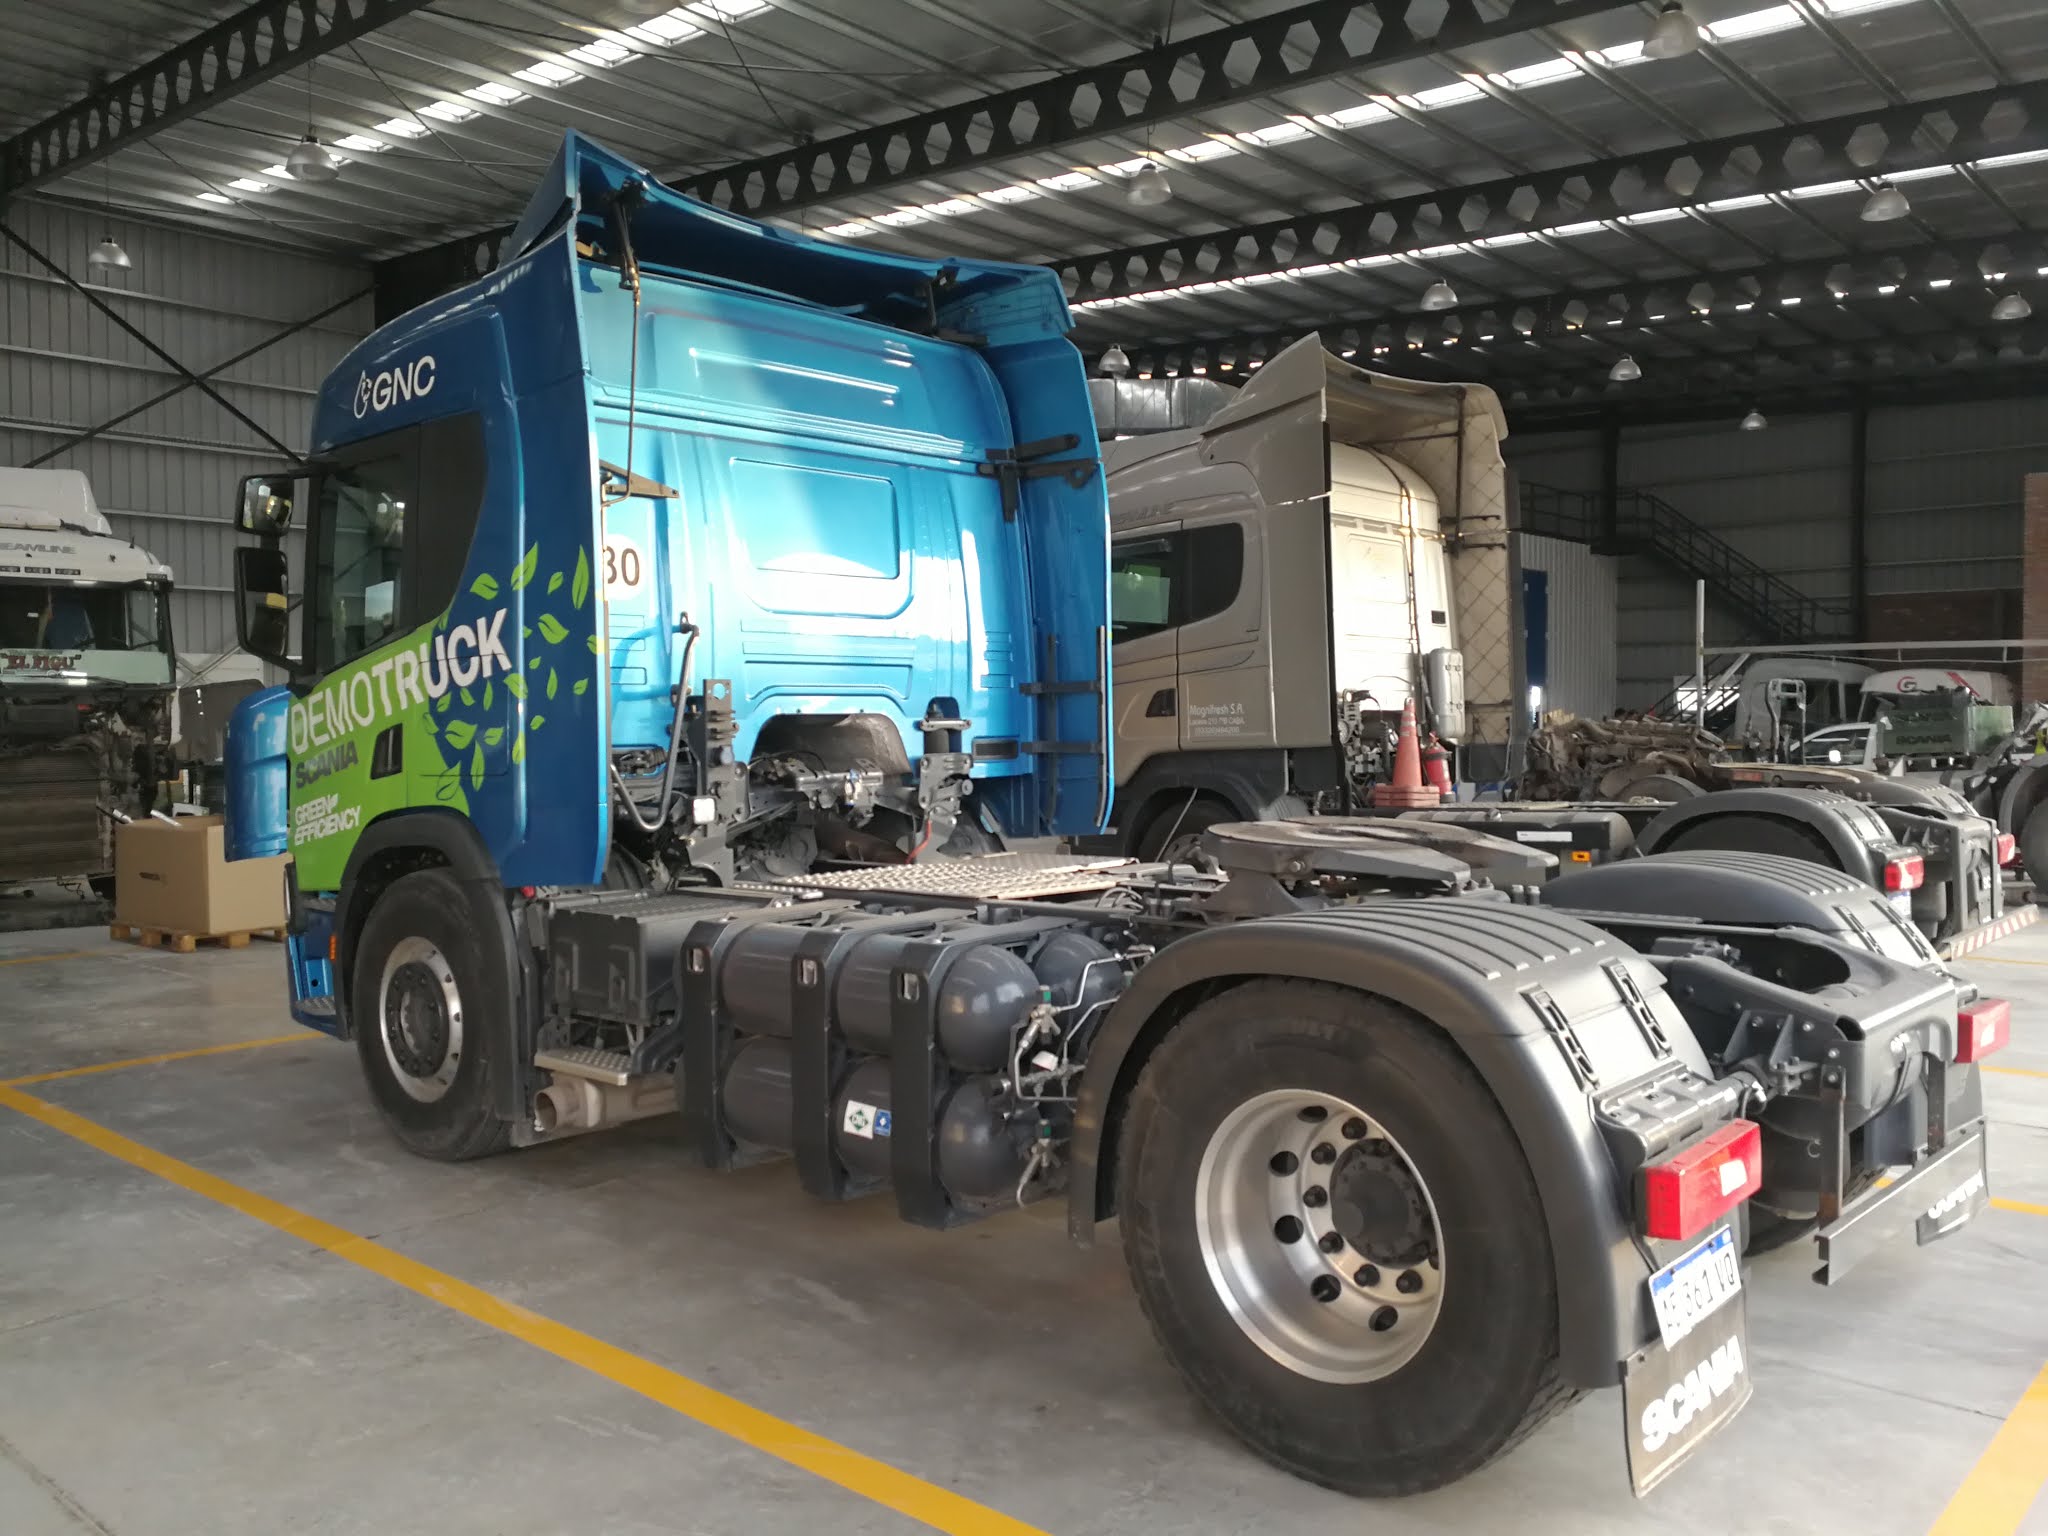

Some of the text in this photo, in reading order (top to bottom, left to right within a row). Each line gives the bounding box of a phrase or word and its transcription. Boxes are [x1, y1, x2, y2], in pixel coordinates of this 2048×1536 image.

[372, 355, 436, 412] GNC
[290, 608, 512, 755] DEMOTRUCK
[296, 740, 359, 789] SCANIA
[294, 805, 361, 846] EFFICIENCY
[295, 794, 333, 826] GREEN
[1641, 1334, 1744, 1452] SCANIA
